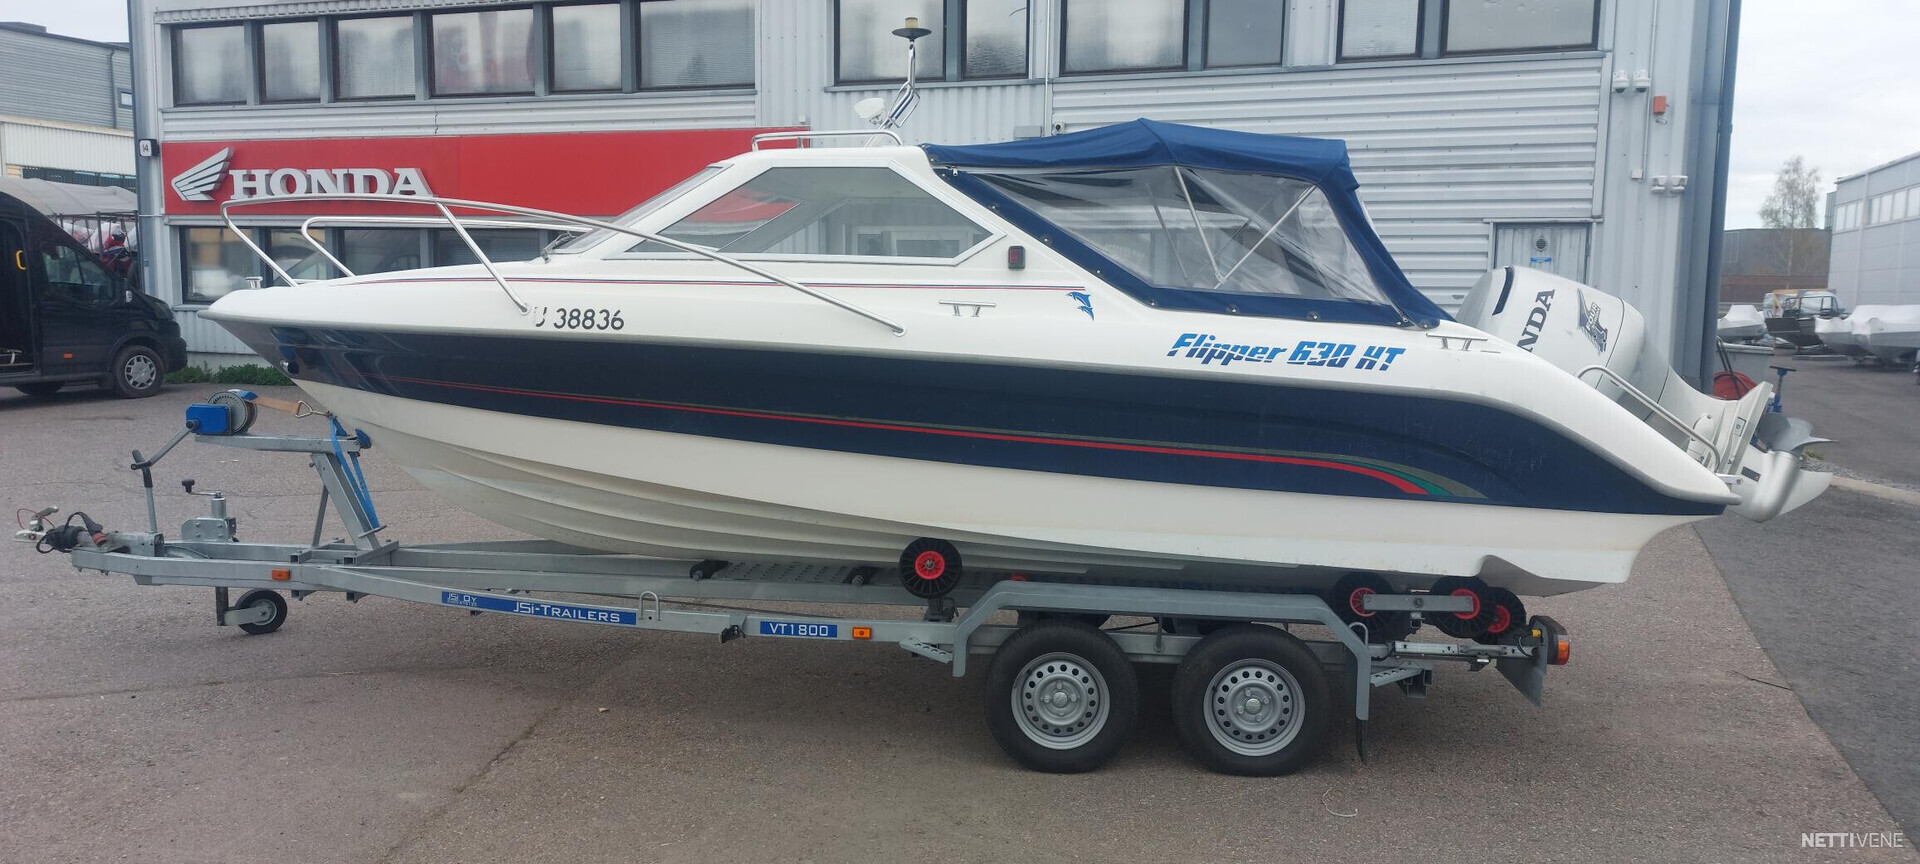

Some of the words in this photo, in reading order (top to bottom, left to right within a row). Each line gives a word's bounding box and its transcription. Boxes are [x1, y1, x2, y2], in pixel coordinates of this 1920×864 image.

[229, 168, 437, 199] HONDA
[553, 307, 625, 331] 38836
[1517, 289, 1555, 353] NDA
[1167, 333, 1287, 366] Flipper
[1287, 341, 1357, 367] 630
[1355, 345, 1406, 371] HT
[769, 622, 829, 637] VT1800
